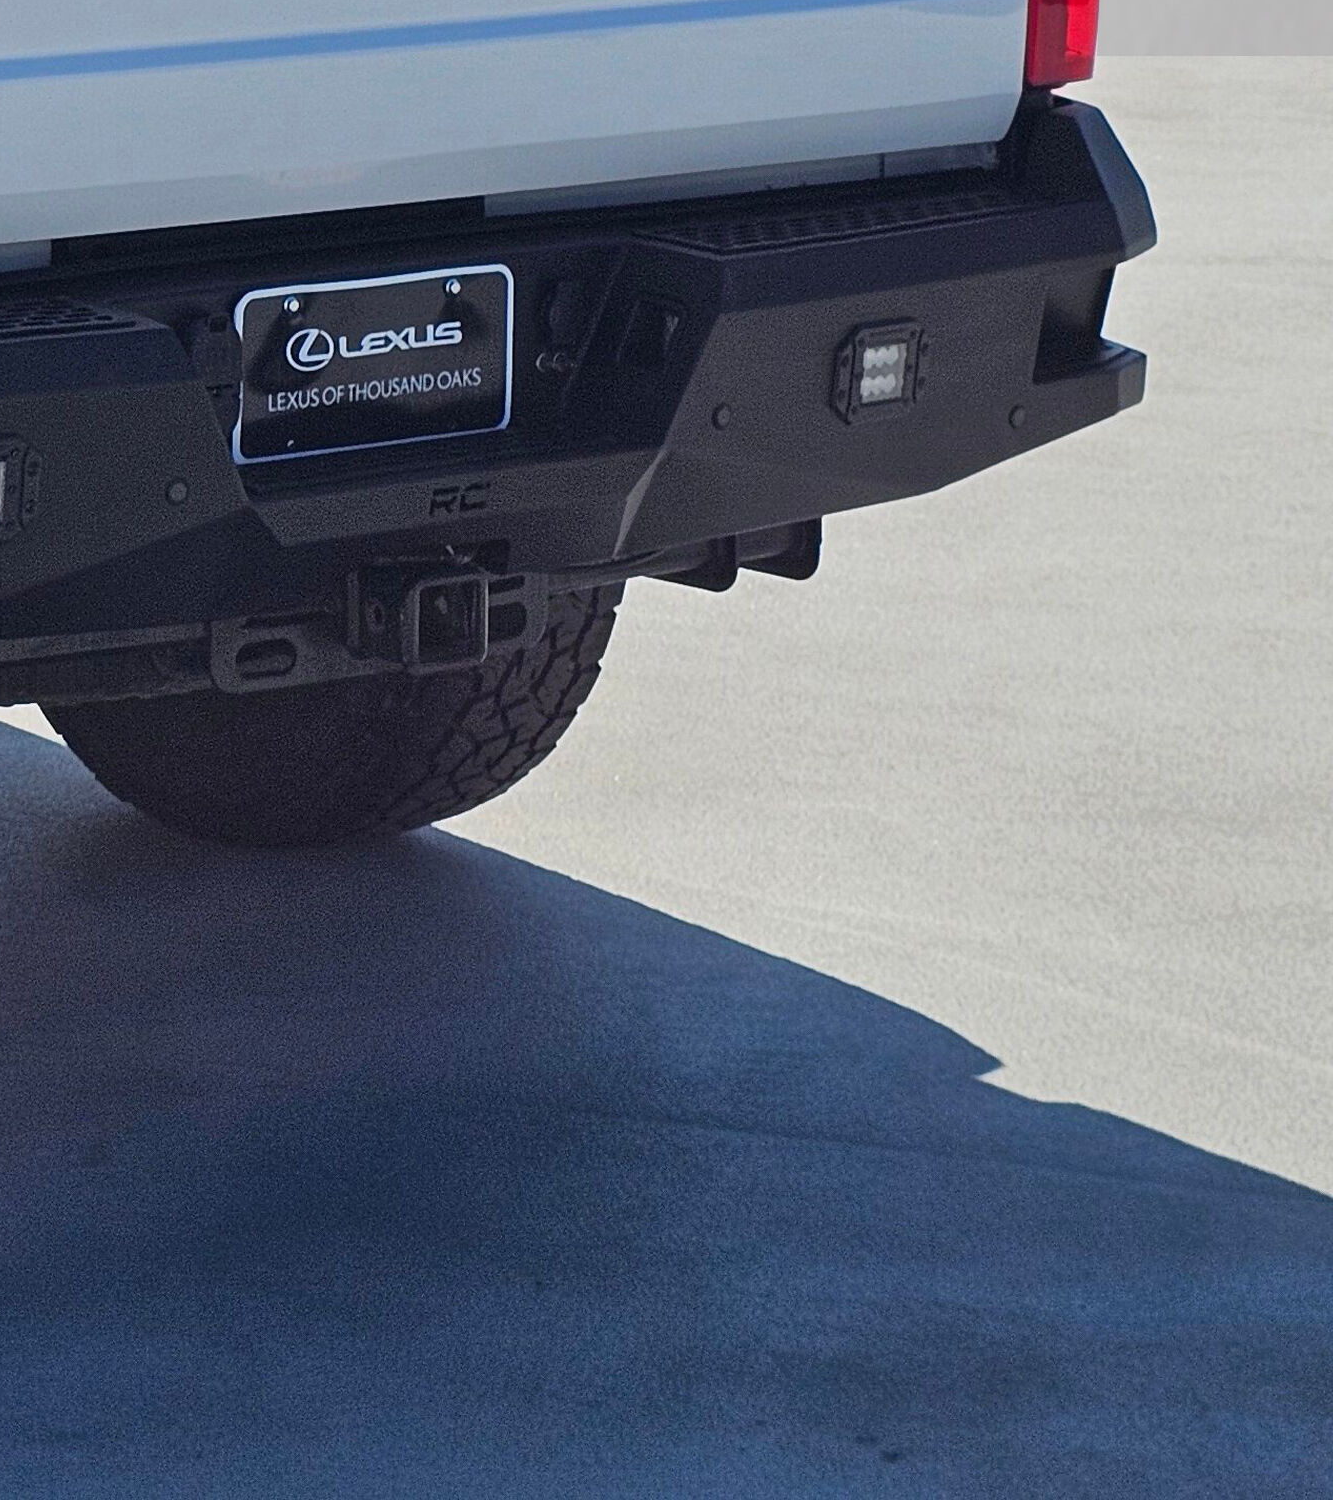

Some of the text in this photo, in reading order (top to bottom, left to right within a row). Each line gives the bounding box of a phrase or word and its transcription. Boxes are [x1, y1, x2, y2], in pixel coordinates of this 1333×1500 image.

[338, 320, 464, 359] LEXUS
[267, 367, 483, 413] LEXUS OF THOUSAND OAKS
[429, 483, 490, 515] RC
